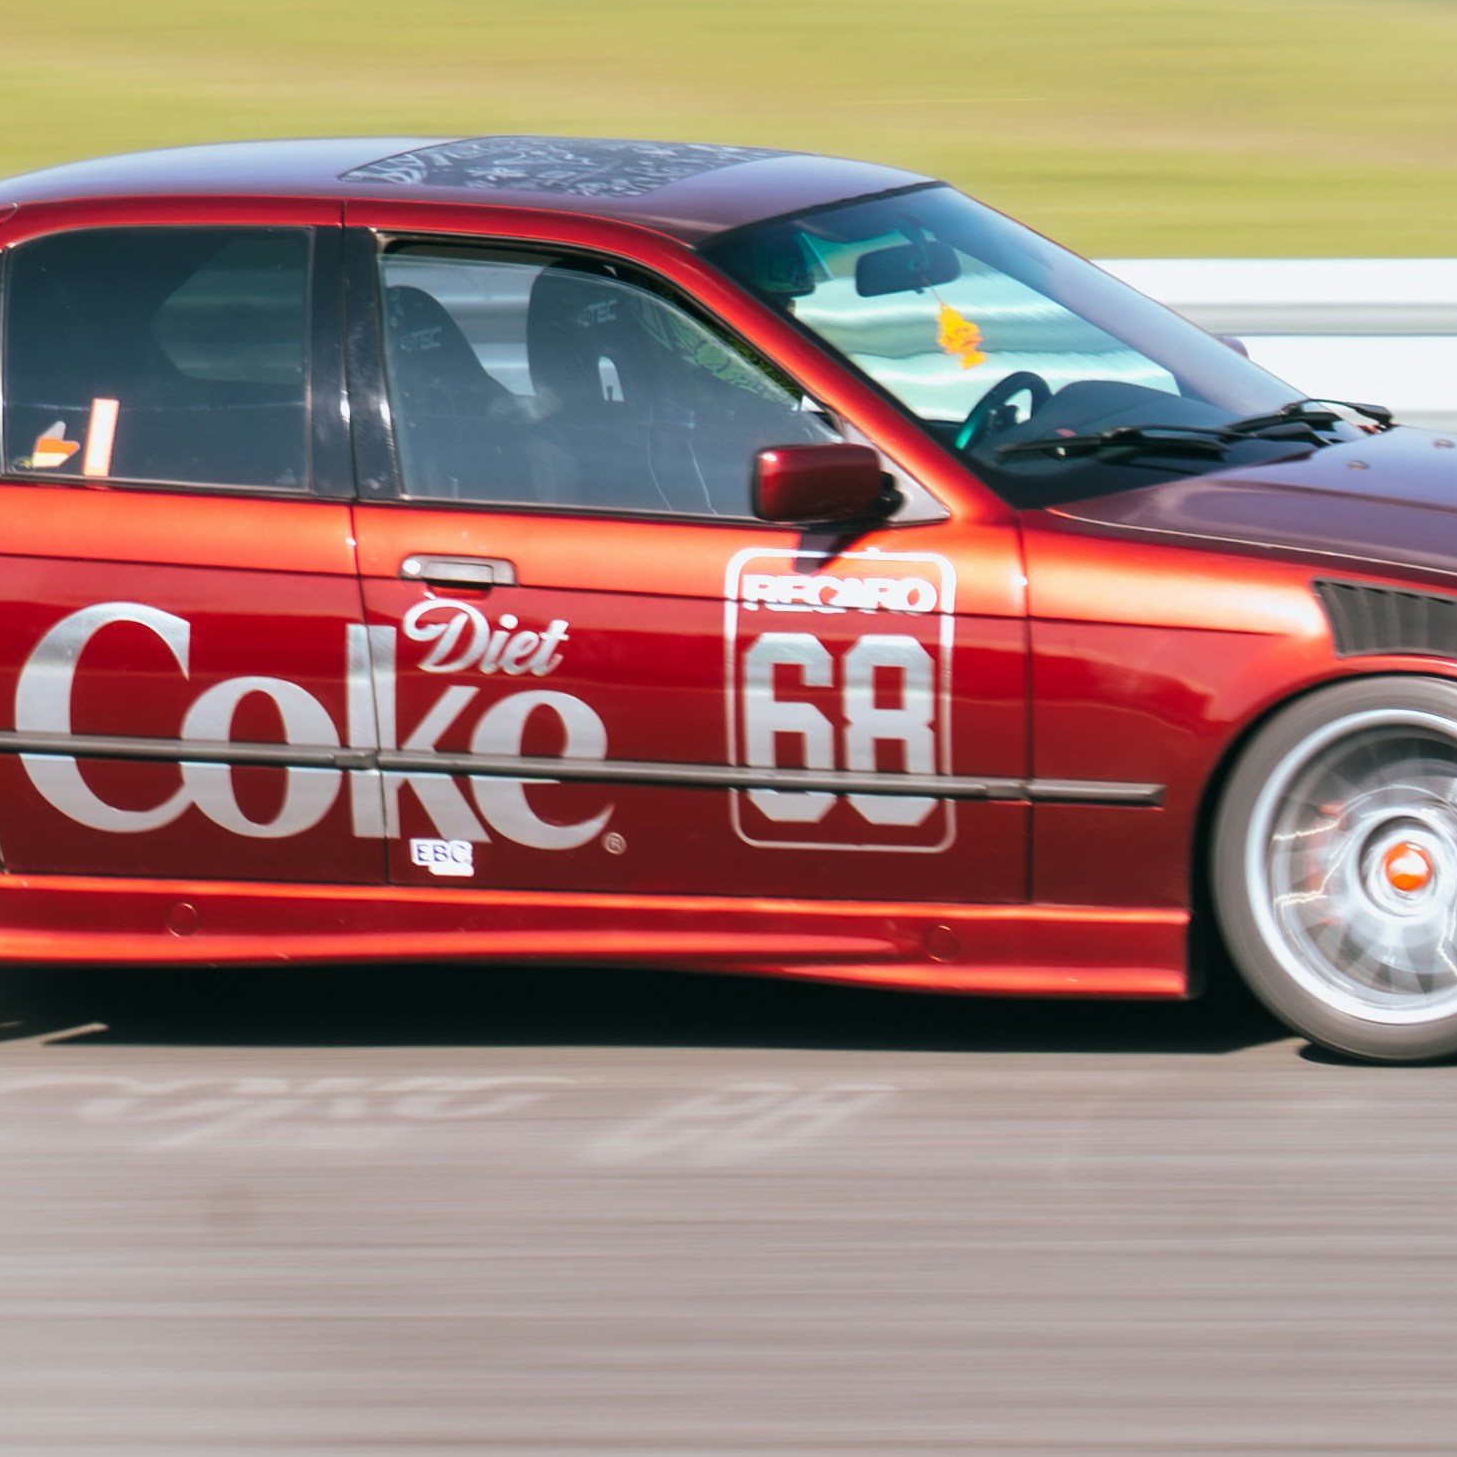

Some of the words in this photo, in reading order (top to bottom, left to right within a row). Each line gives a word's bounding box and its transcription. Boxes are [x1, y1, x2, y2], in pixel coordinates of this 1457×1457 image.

[742, 573, 938, 615] RECARO
[402, 597, 570, 677] Diet
[14, 600, 615, 851] Coke
[743, 631, 940, 827] 68
[415, 843, 469, 864] EBC
